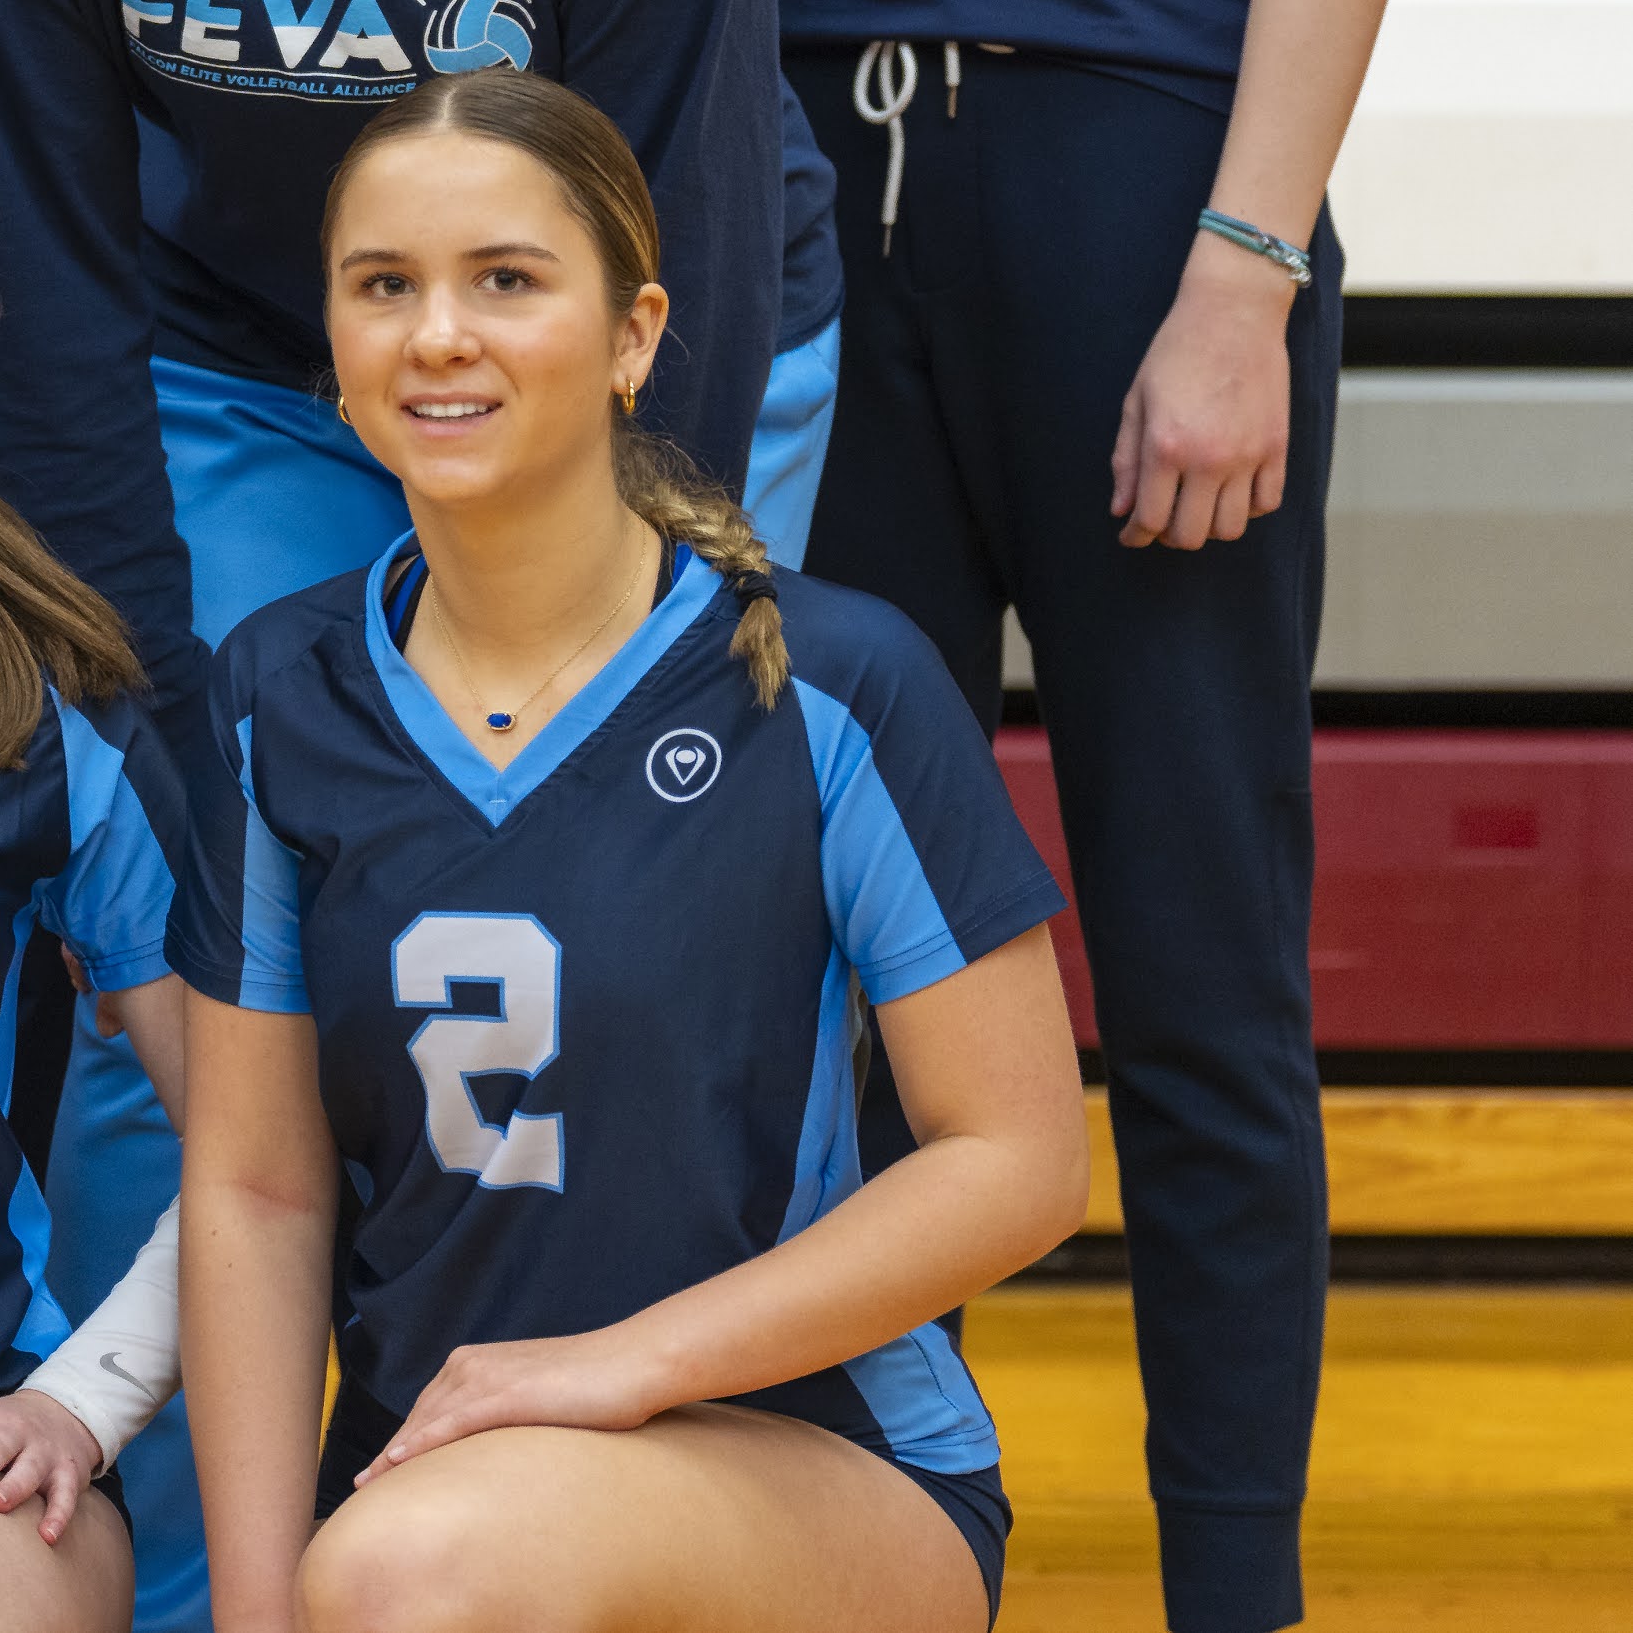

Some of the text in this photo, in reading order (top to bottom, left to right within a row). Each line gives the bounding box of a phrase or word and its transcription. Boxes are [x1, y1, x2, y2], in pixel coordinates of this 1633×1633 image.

[128, 40, 177, 73] FALCON
[180, 64, 223, 84] ELITE
[226, 74, 328, 94] VOLLEYBALL
[391, 910, 564, 1194] 2
